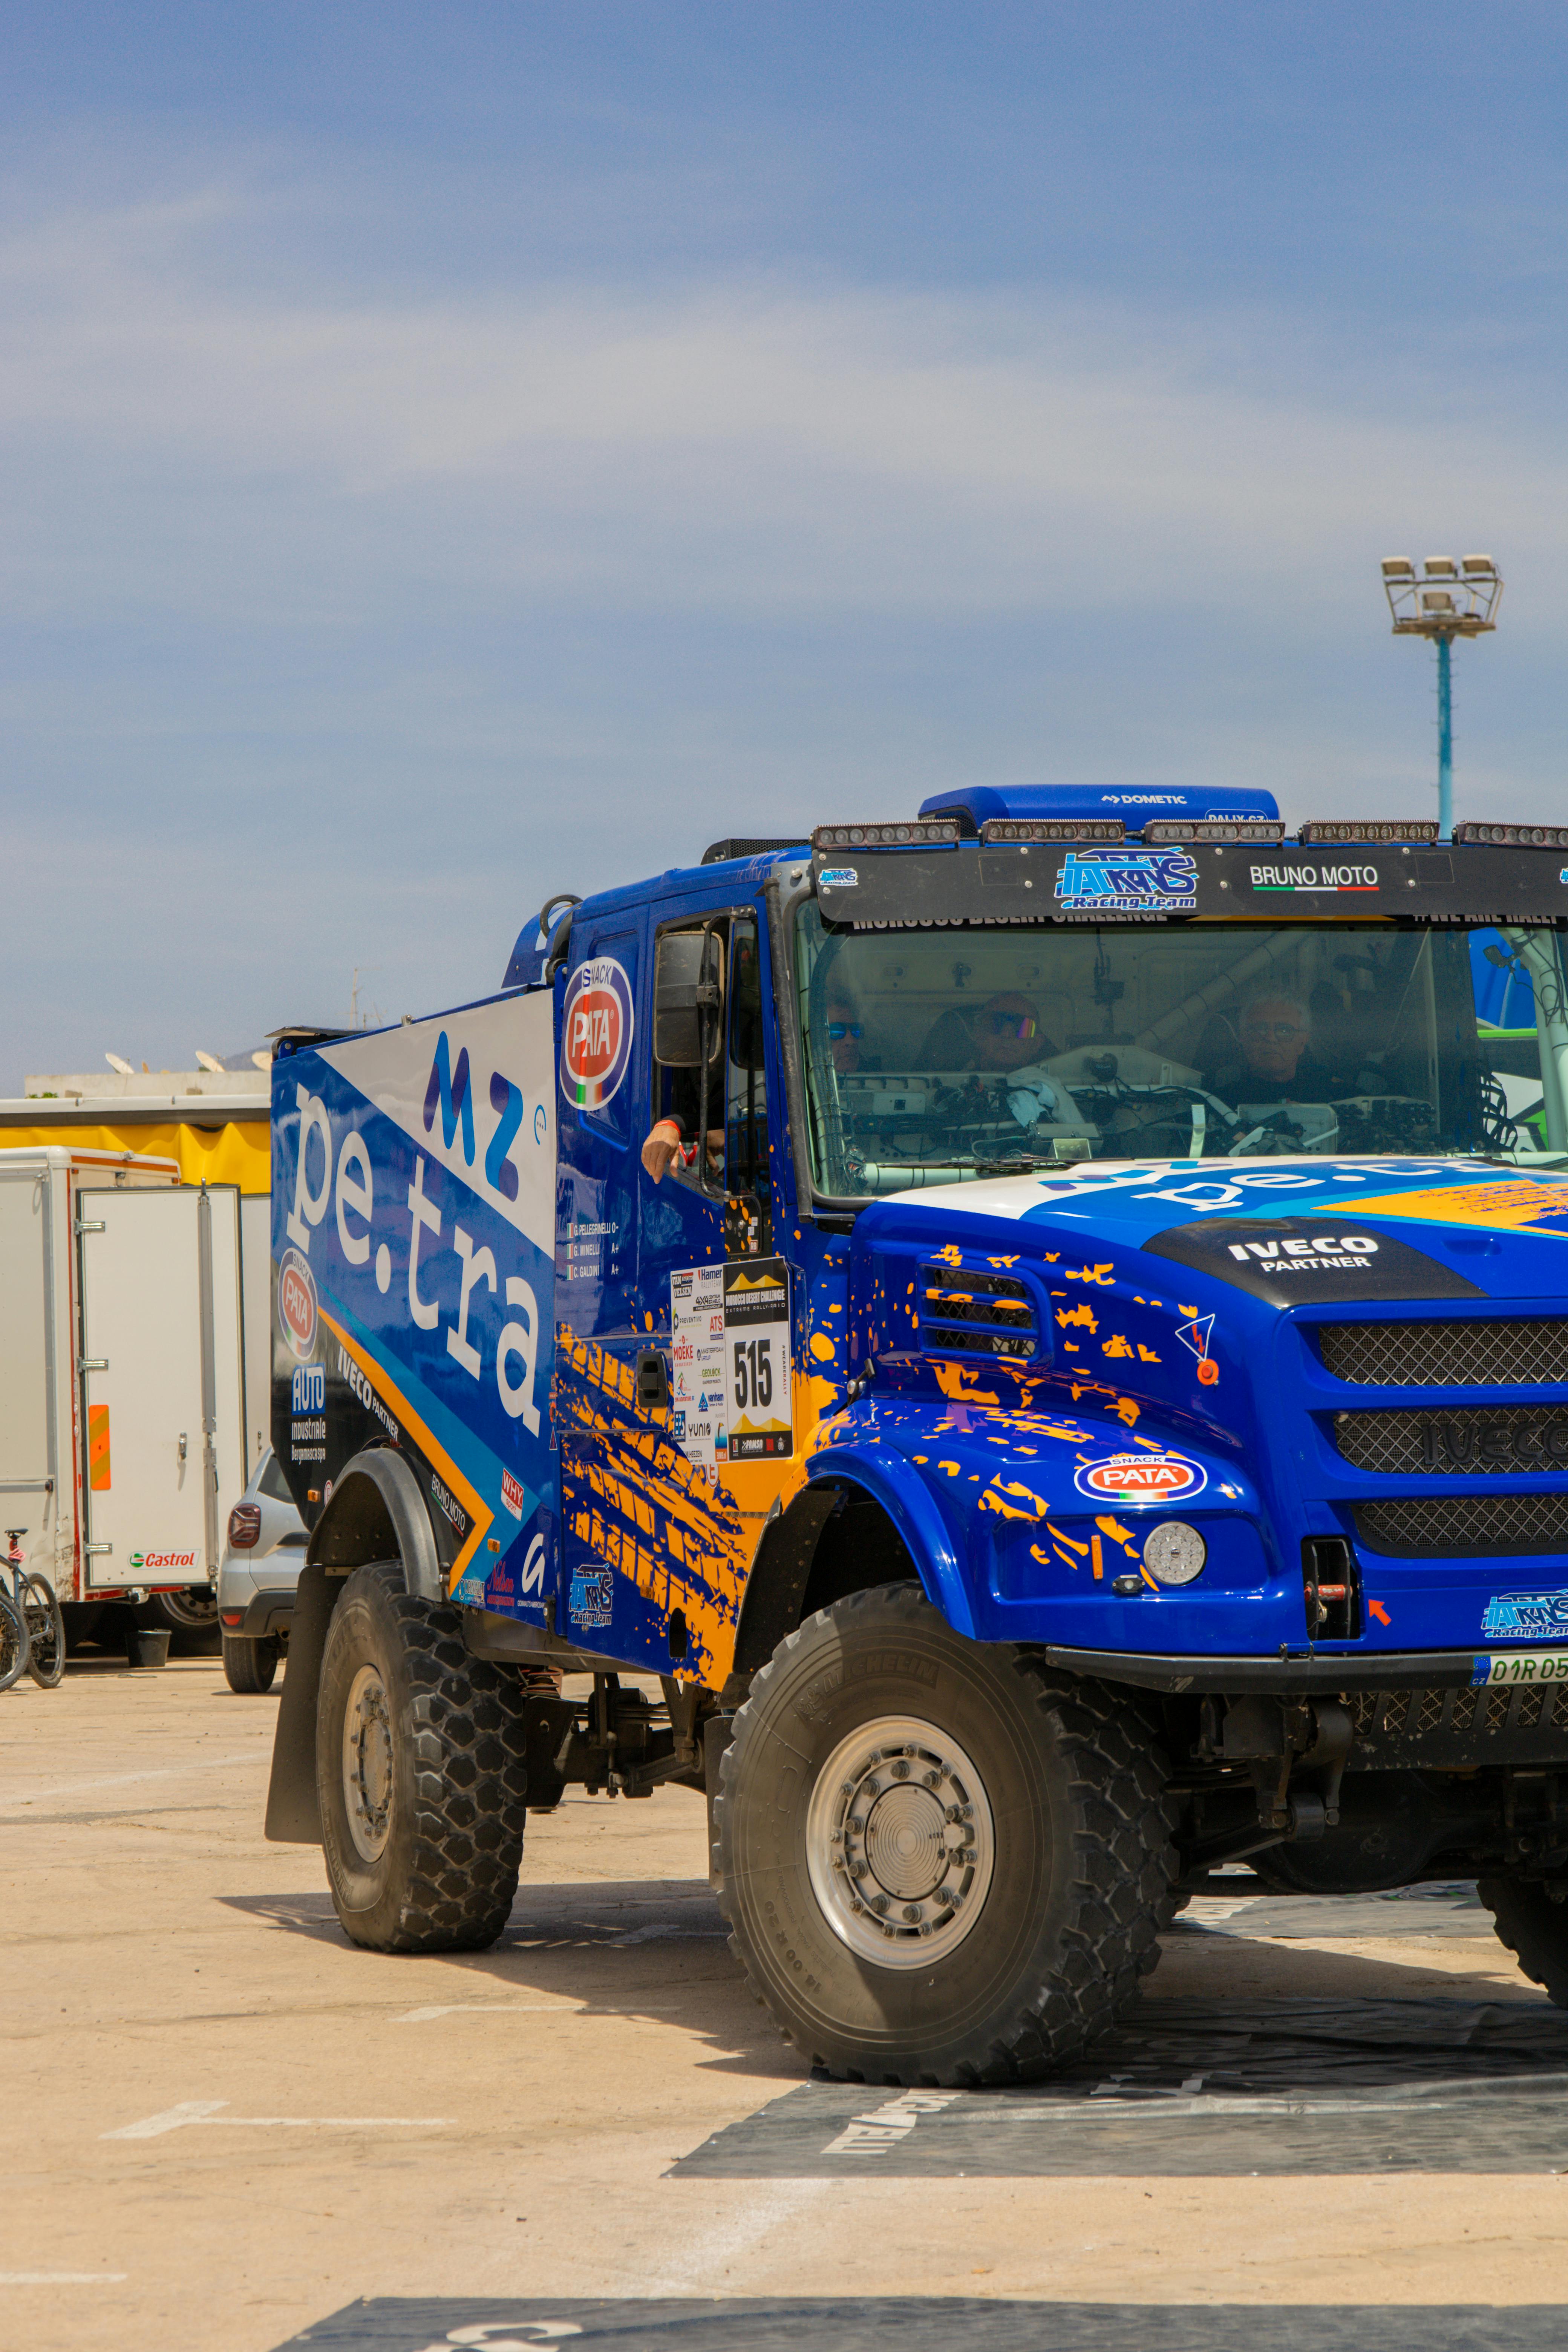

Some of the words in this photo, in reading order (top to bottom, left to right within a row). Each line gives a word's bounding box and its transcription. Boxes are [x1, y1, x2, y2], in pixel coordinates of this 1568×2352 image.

[1121, 795, 1187, 804] DOMETIC
[1250, 866, 1316, 885] BRUNO
[1322, 866, 1378, 885] MOTO
[1073, 896, 1141, 909] Racing
[1145, 896, 1196, 908] Team
[582, 965, 612, 988] SNACK
[571, 1009, 611, 1057] PATA
[574, 1225, 579, 1236] G.
[579, 1222, 611, 1236] PELLEGRINELLI
[574, 1245, 579, 1257] G.
[580, 1244, 600, 1256] MINELLI
[611, 1242, 619, 1254] A+
[1228, 1237, 1379, 1260] IVECO
[292, 1253, 309, 1281] SNACK
[574, 1267, 579, 1278] C.
[580, 1265, 599, 1278] GALDINI
[611, 1263, 619, 1275] A+
[1260, 1257, 1372, 1272] PARTNER
[672, 1276, 681, 1285] VAN
[701, 1269, 722, 1280] Hamer
[674, 1286, 691, 1297] VELSEN
[726, 1293, 746, 1306] MOROCCO
[746, 1292, 760, 1304] DESERT
[760, 1289, 785, 1303] CHALLENGE
[285, 1276, 308, 1332] PATA
[710, 1315, 723, 1332] ATS
[673, 1345, 693, 1361] MOEKE
[734, 1339, 772, 1409] 515
[293, 1366, 325, 1412] AUTO
[338, 1346, 372, 1410] IVECO
[372, 1396, 398, 1441] PARTNER
[1423, 1421, 1568, 1465] IVECO
[1103, 1468, 1178, 1485] PATA
[503, 1472, 523, 1505] WHY
[431, 1474, 449, 1510] BRUNO
[449, 1498, 466, 1531] MOTO
[506, 1498, 516, 1514] sport
[145, 1552, 194, 1567] Castrol
[574, 1612, 594, 1624] Racing
[596, 1612, 611, 1624] Team
[1493, 1627, 1538, 1637] Racing
[823, 1654, 940, 1692] MICHELIN
[1492, 1659, 1537, 1681] 01R
[1540, 1658, 1568, 1679] 05
[764, 1900, 780, 1927] 20
[775, 1929, 789, 1947] R
